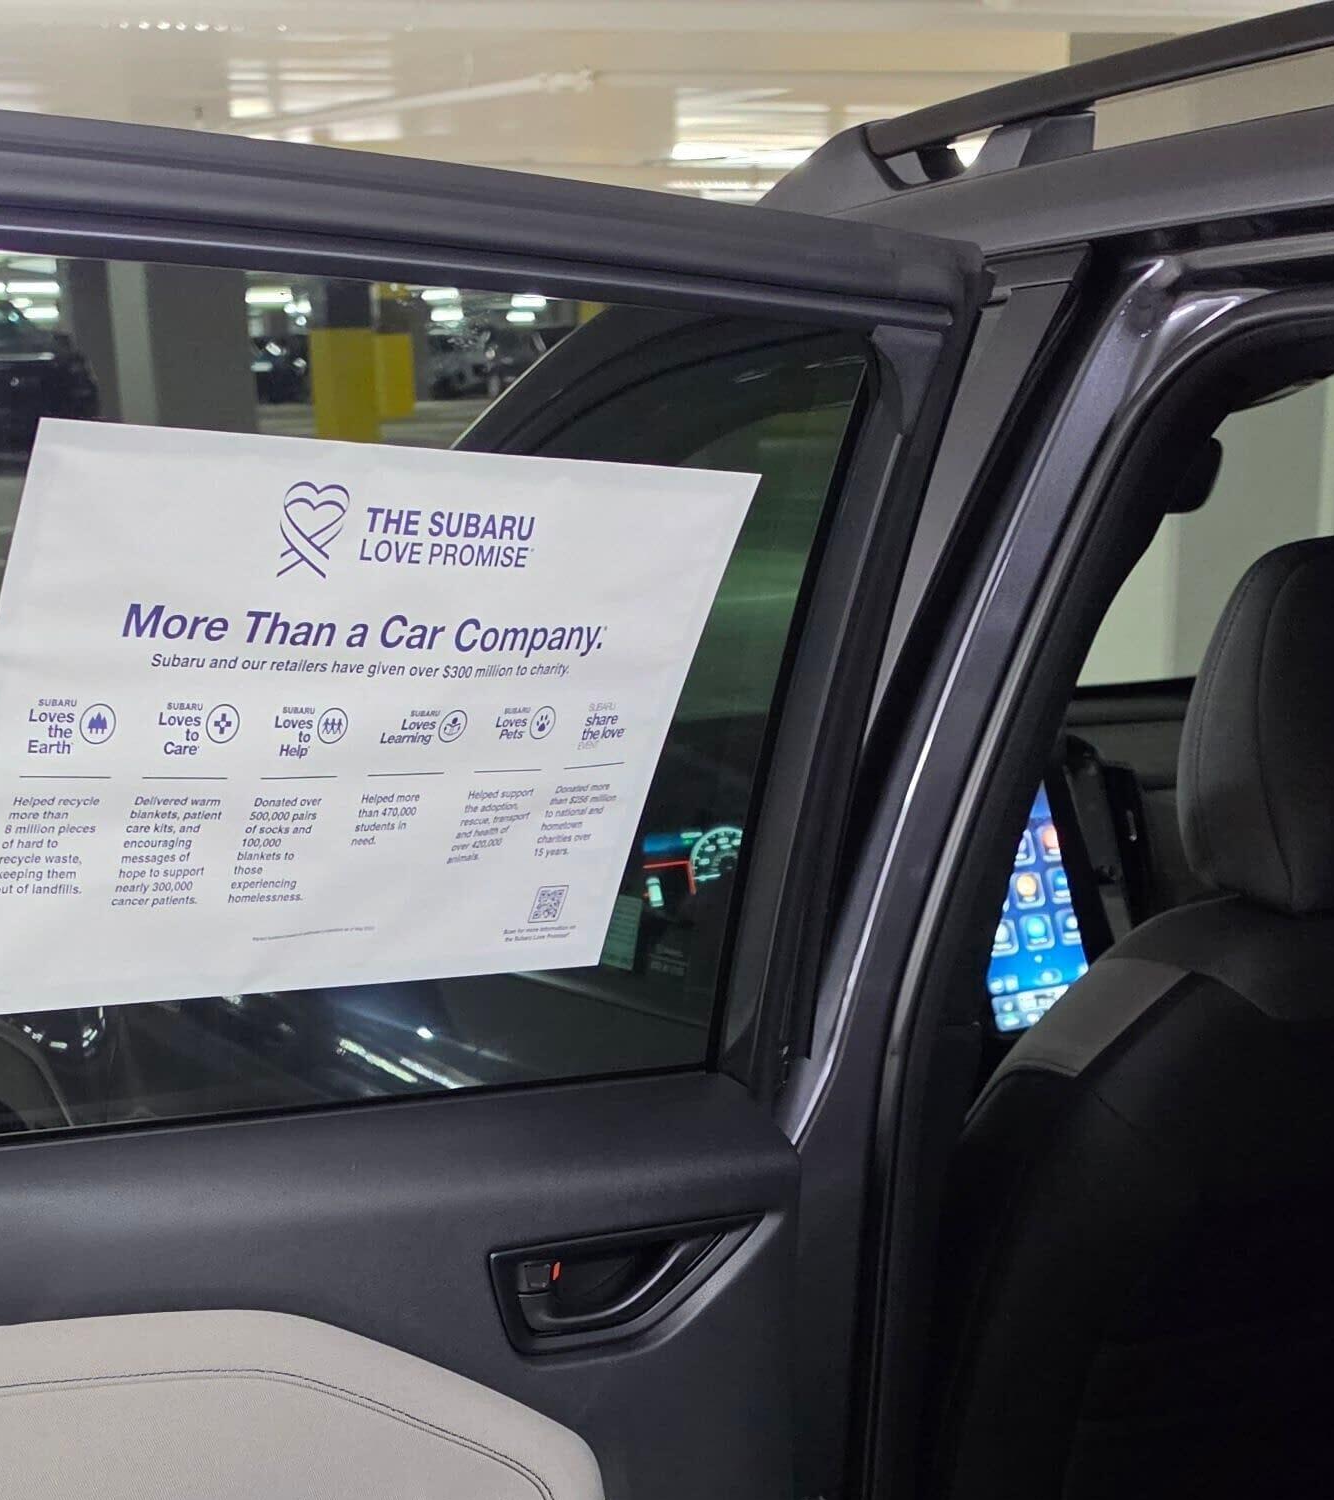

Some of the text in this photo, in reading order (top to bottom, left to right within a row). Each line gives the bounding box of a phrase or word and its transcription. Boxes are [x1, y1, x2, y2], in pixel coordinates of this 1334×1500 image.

[366, 507, 535, 541] THE SUBARU
[358, 539, 528, 569] LOVE PROMISE
[122, 602, 604, 659] More Than a Car Company.
[150, 653, 571, 680] Subaru and our retailers have given over $300 million to charity.
[38, 699, 77, 707] SUBARU
[166, 702, 204, 711] SUBARU
[588, 702, 616, 712] SUBARU
[28, 708, 75, 723] Loves
[282, 706, 316, 715] SUBARU
[410, 709, 441, 717] SUBARU
[504, 706, 531, 714] SUBARU
[158, 712, 202, 727] Loves
[274, 715, 313, 730] Loves
[400, 718, 437, 731] Loves
[495, 716, 527, 729] Loves
[585, 712, 619, 726] share
[48, 725, 73, 739] the
[185, 728, 200, 742] to
[298, 730, 311, 743] to
[499, 728, 525, 741] Pets
[581, 726, 624, 741] the love
[380, 732, 432, 745] Learning
[27, 740, 71, 755] Earth
[163, 741, 198, 756] Care
[278, 744, 308, 759] Help
[554, 783, 610, 794] Donated more
[12, 796, 100, 808] Helped recycle
[134, 796, 221, 807] Delivered warm
[253, 797, 322, 808] Donated over
[360, 793, 420, 805] Helped more
[8, 810, 69, 820] more than
[129, 810, 222, 822] blankets, patient
[249, 811, 317, 822] 500,000 pairs
[358, 806, 417, 818] than 470,000
[4, 823, 96, 836] 8 million pieces
[125, 823, 201, 835] care kits, and
[245, 824, 312, 834] of socks and
[354, 820, 407, 833] students in
[1, 839, 59, 849] of hard to
[123, 838, 192, 850] encouraging
[241, 837, 282, 849] 100,000
[44, 854, 83, 866] waste,
[121, 852, 190, 865] messages of
[237, 851, 295, 861] blankets to
[45, 869, 77, 880] them
[118, 865, 205, 880] hope to support
[233, 865, 263, 876] those
[15, 884, 30, 895] of
[31, 884, 83, 895] landfills.
[115, 881, 193, 894] nearly 300,000
[230, 878, 297, 891] experiencing
[111, 895, 197, 908] cancer patients.
[227, 892, 304, 904] homelessness.
